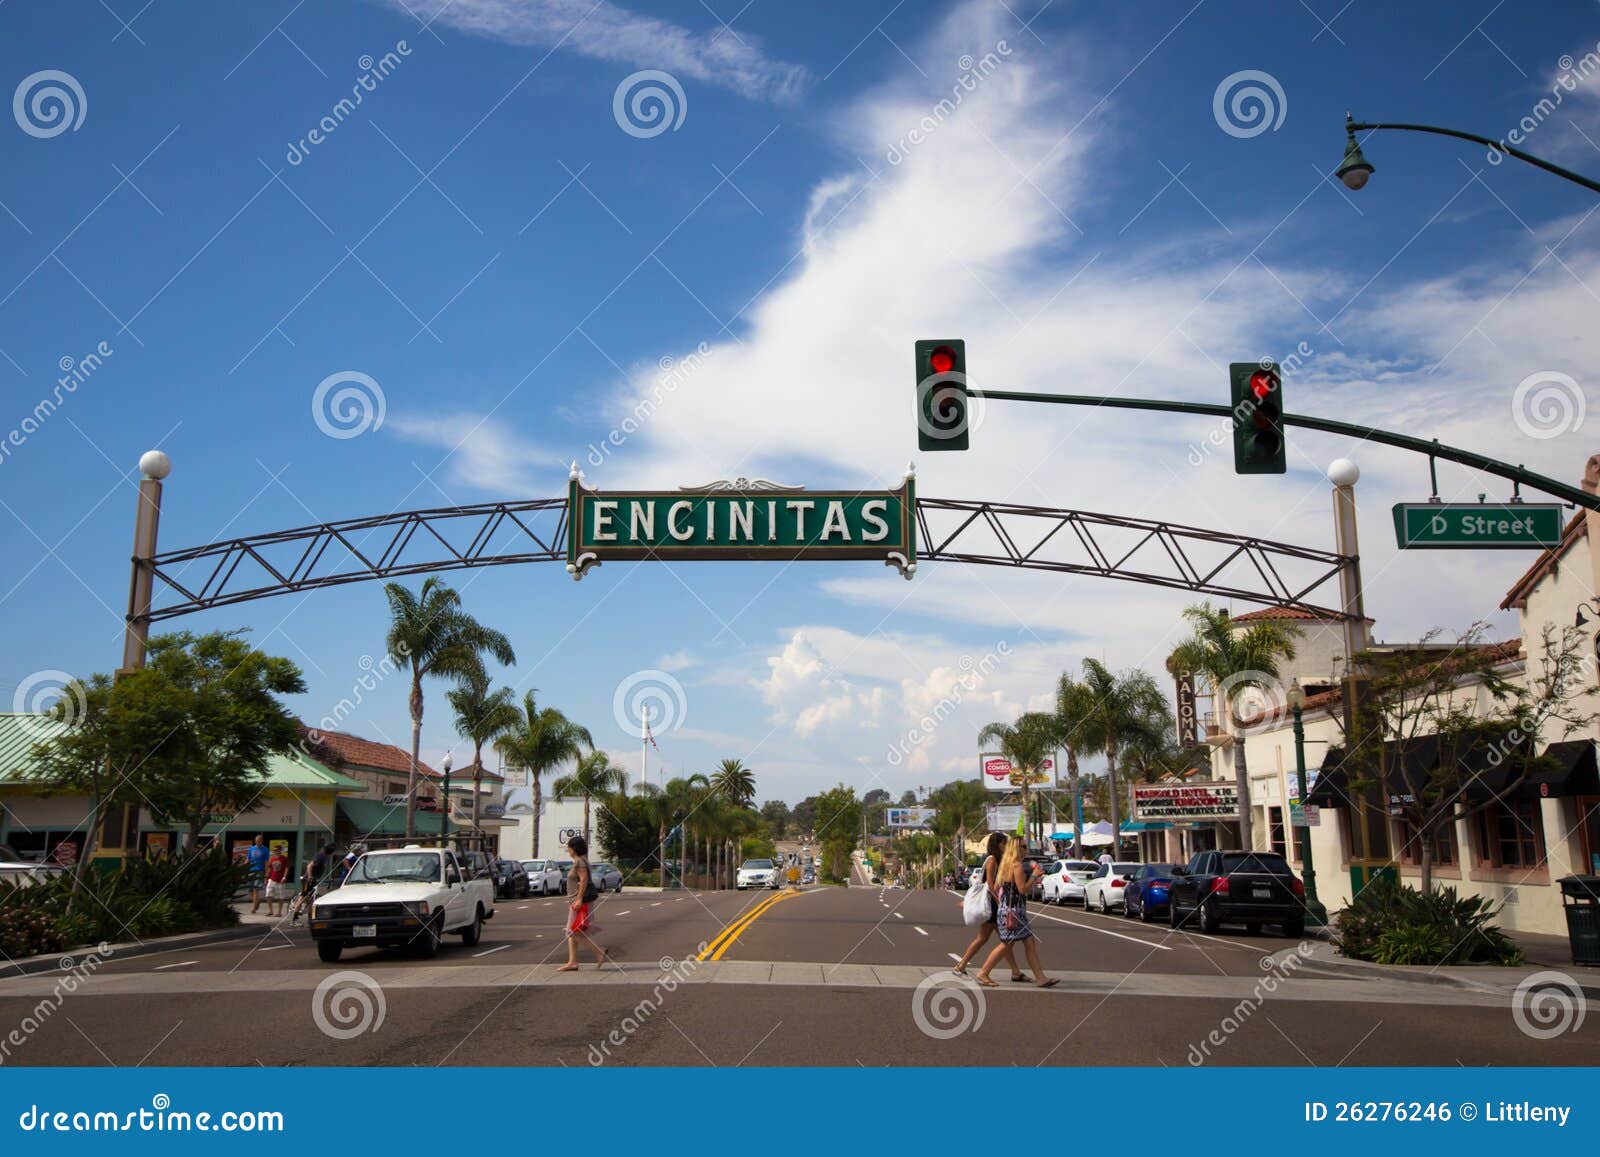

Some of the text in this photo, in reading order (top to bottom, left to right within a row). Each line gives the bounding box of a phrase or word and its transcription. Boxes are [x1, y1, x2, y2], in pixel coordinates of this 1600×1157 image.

[593, 500, 890, 541] ENCINITAS
[1432, 515, 1535, 534] D Street
[1180, 670, 1195, 741] PALOMA
